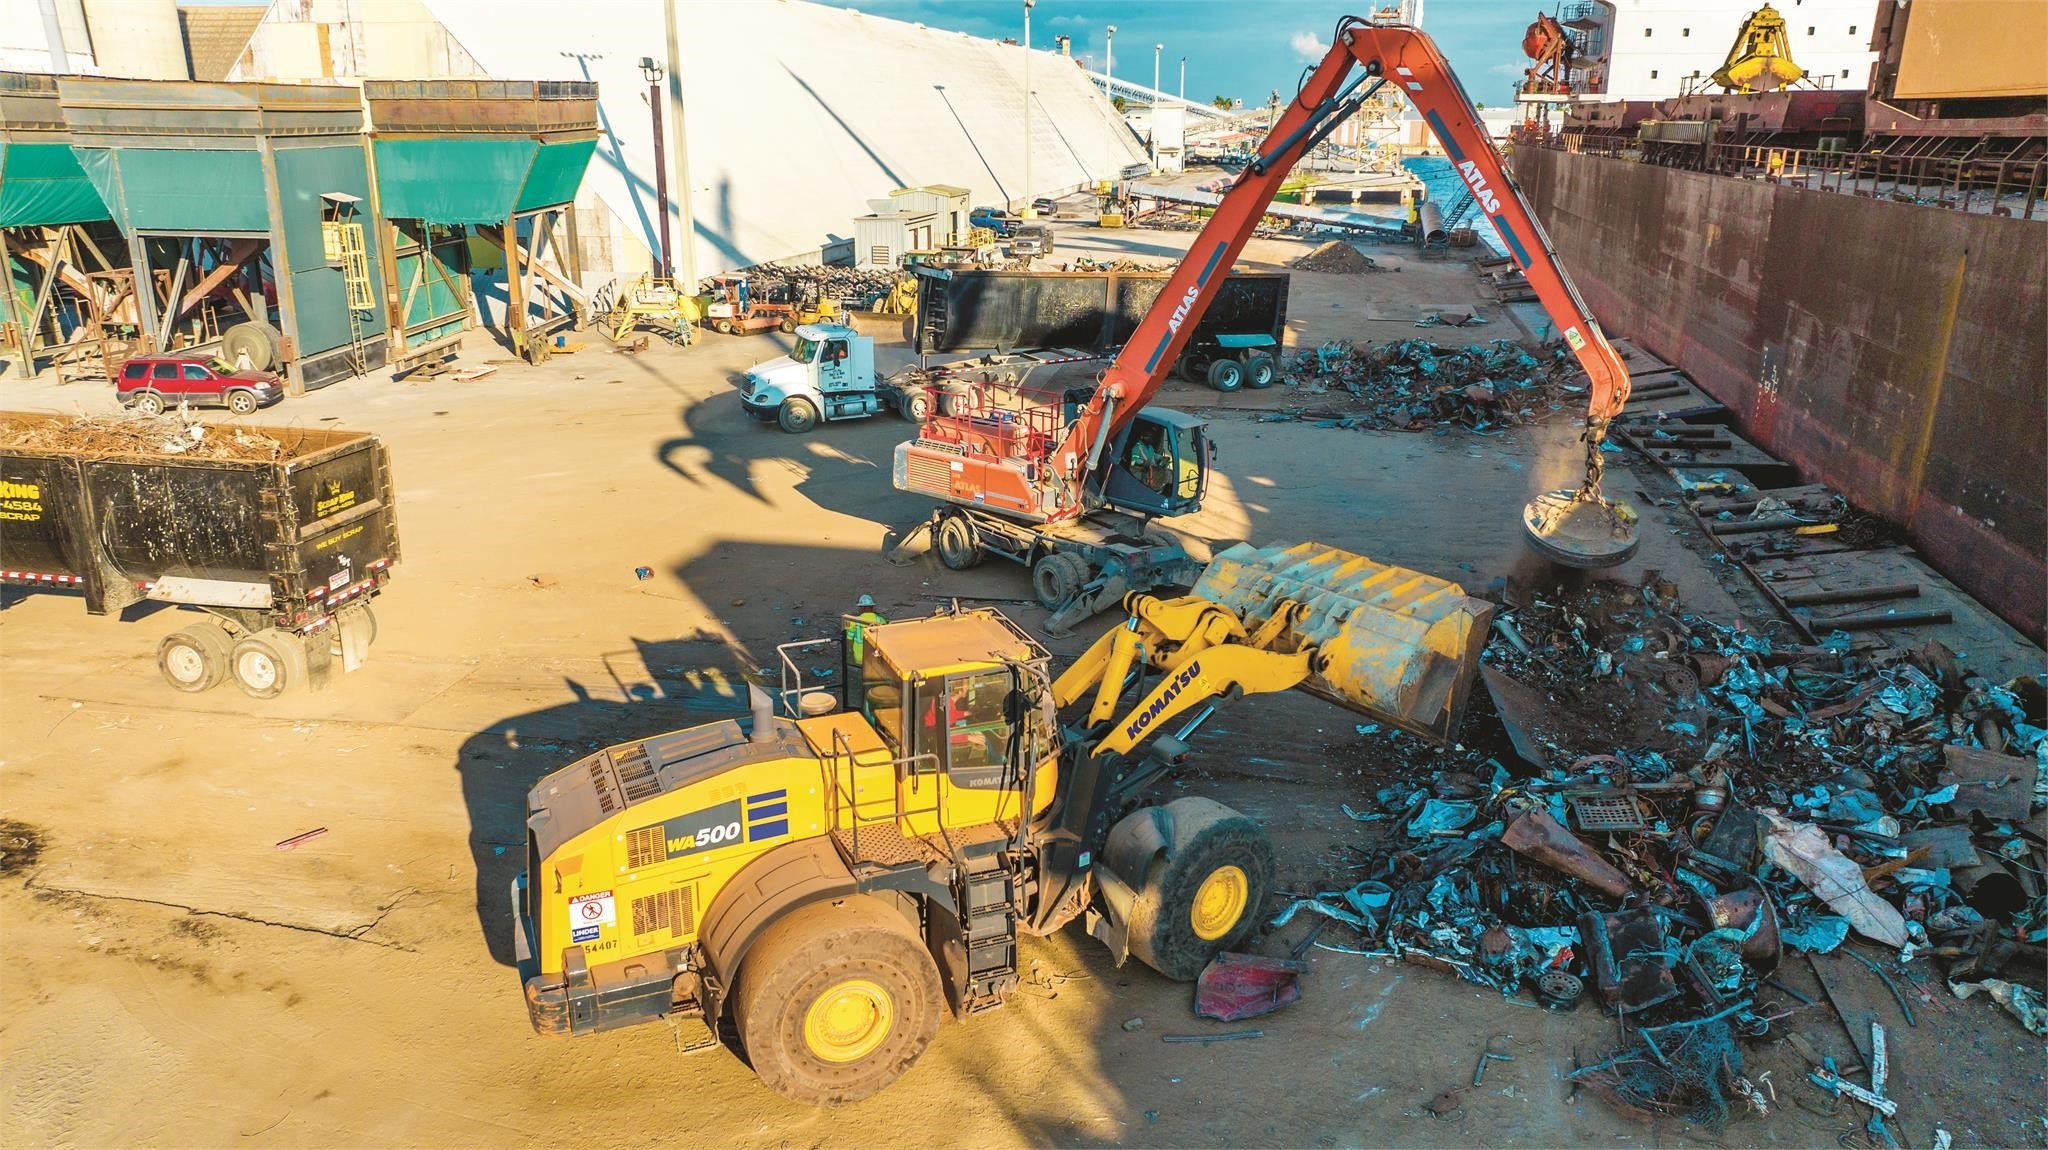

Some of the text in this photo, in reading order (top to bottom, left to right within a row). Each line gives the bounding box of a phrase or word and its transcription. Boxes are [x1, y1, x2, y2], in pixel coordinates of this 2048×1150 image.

[1458, 160, 1500, 213] ATLAS
[1168, 286, 1199, 334] ATLAS
[1126, 660, 1201, 741] KOMATSU
[667, 821, 741, 853] WA500
[579, 891, 611, 902] DANGER
[585, 939, 617, 953] 54407
